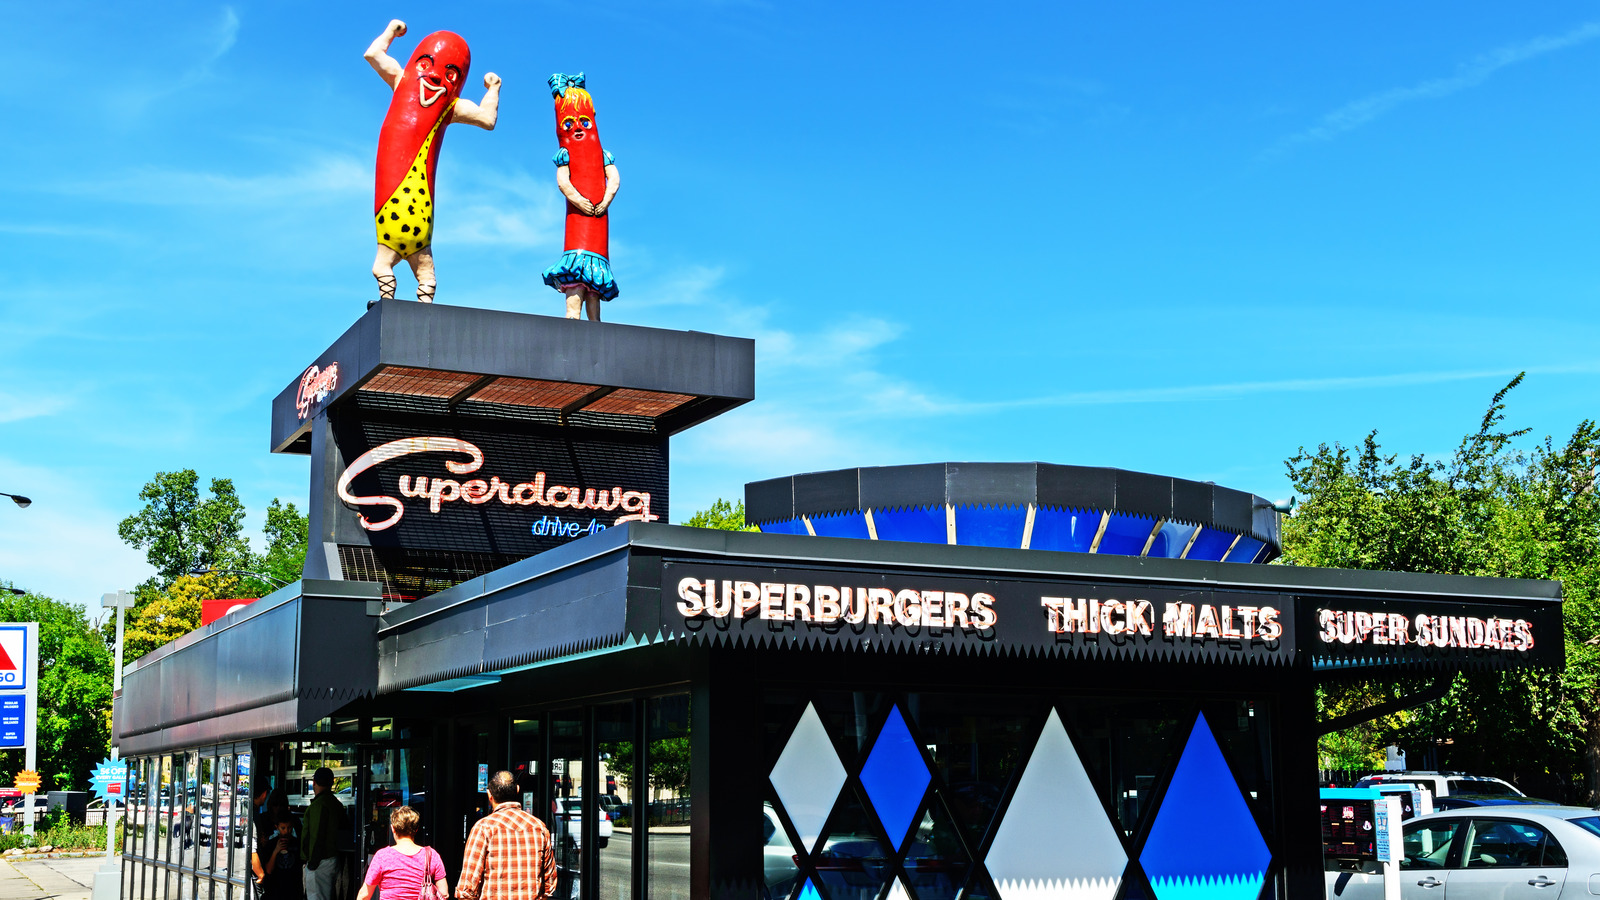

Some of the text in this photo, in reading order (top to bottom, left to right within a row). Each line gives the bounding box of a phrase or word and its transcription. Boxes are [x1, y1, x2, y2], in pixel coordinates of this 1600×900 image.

[337, 436, 660, 531] Superdawg
[676, 577, 997, 630] SUPERBURGERS
[1041, 596, 1282, 641] THICK MALTS
[1318, 608, 1534, 651] SUPER SUNDAES
